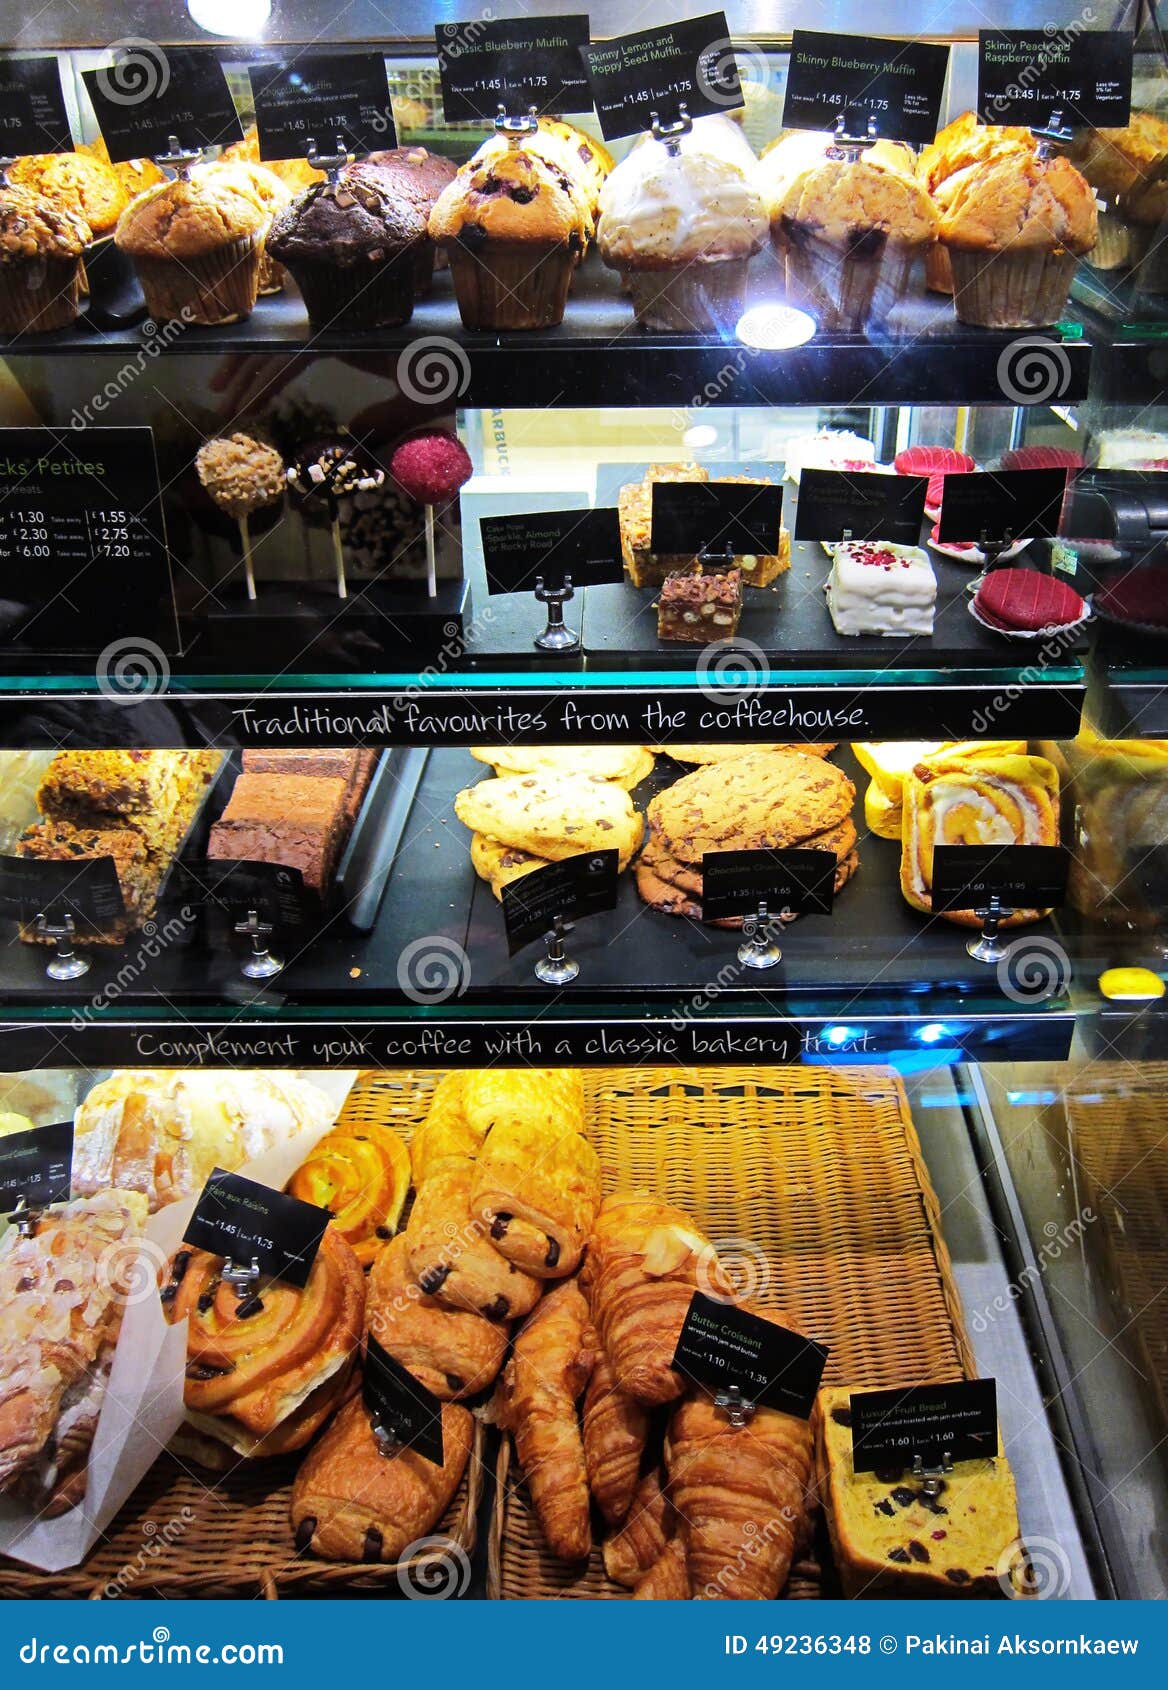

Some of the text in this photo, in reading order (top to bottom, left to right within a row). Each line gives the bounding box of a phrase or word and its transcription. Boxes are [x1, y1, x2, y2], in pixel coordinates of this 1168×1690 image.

[485, 39, 534, 52] Blueberry
[536, 37, 568, 47] Muffin
[587, 33, 674, 64] Skinny Lemon and
[985, 40, 1071, 53] Skinny Peach and
[592, 46, 681, 75] Poppy Seed Muffin
[796, 52, 916, 76] Skinny Blueberry Muffin
[985, 52, 1070, 65] Raspberry Muffin
[902, 107, 930, 115] Vegetarian
[38, 458, 105, 475] Petites
[526, 528, 561, 539] Almond
[501, 541, 527, 552] Rocky
[530, 540, 553, 549] Road
[232, 699, 869, 735] Traditional favourites from the coffeehouse.
[137, 1031, 300, 1064] Complement
[313, 1036, 373, 1062] your
[386, 1029, 472, 1055] coffee
[485, 1030, 542, 1054] with
[554, 1037, 572, 1054] a
[585, 1029, 677, 1054] classic
[692, 1030, 788, 1060] bakery
[209, 1184, 226, 1197] Pain
[243, 1198, 269, 1216] Raisins
[691, 1311, 764, 1349] Butter Croissant
[688, 1325, 759, 1359] served with jam and butter
[895, 1404, 916, 1416] Fruit
[919, 1401, 947, 1412] Bread
[883, 1419, 902, 1427] served
[939, 1414, 951, 1422] jam
[963, 1409, 982, 1417] butter
